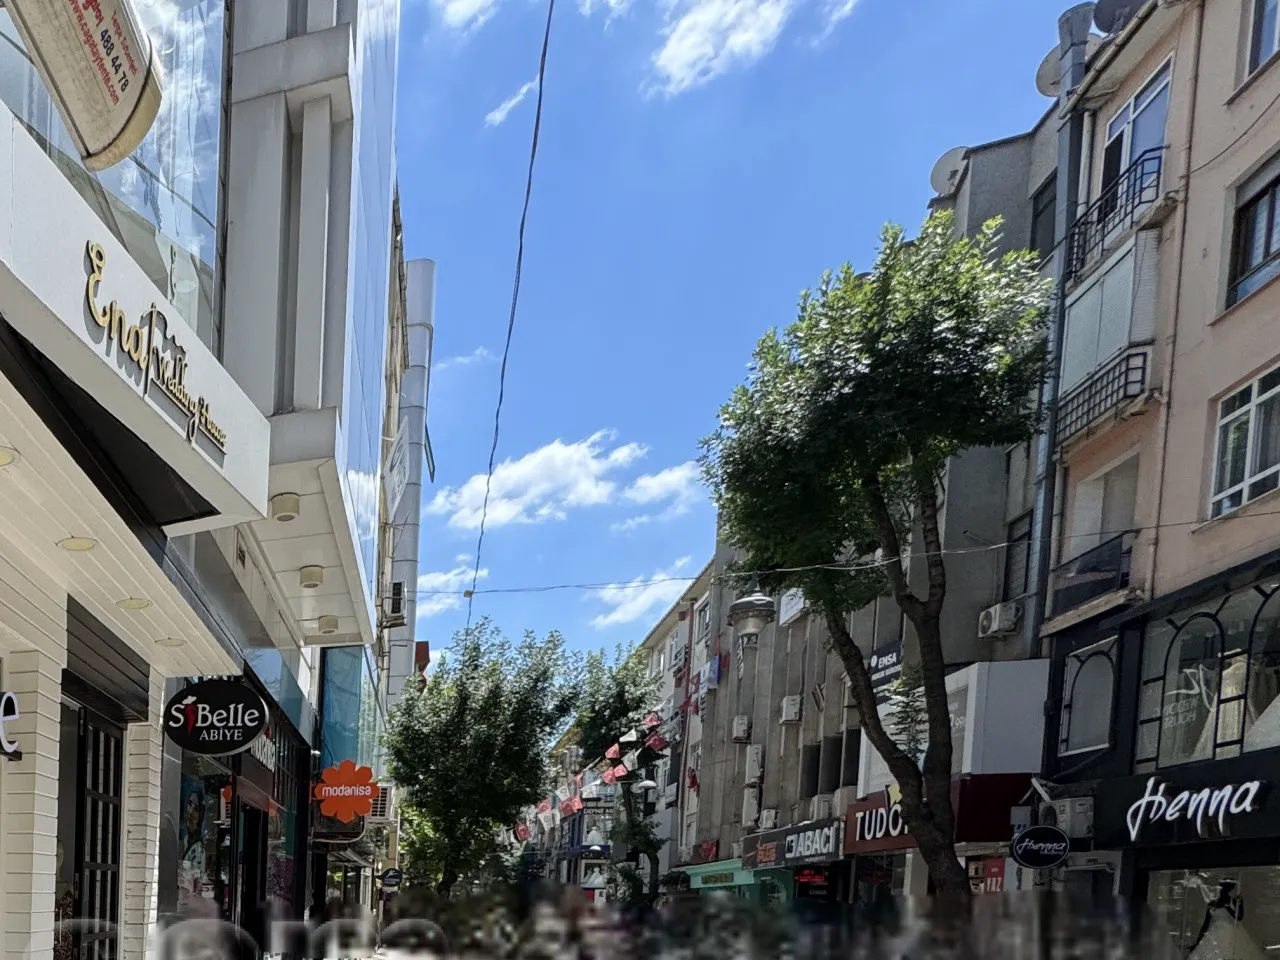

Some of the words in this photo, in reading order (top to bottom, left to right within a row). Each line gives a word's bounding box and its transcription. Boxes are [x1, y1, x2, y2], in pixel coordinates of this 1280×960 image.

[100, 28, 115, 57] 488
[110, 55, 123, 75] 44
[117, 71, 130, 92] 78
[198, 727, 244, 741] ABİYE
[321, 784, 372, 797] modanisa
[855, 803, 910, 842] TUDO
[1126, 776, 1260, 842] Henna
[1016, 838, 1067, 855] Henna
